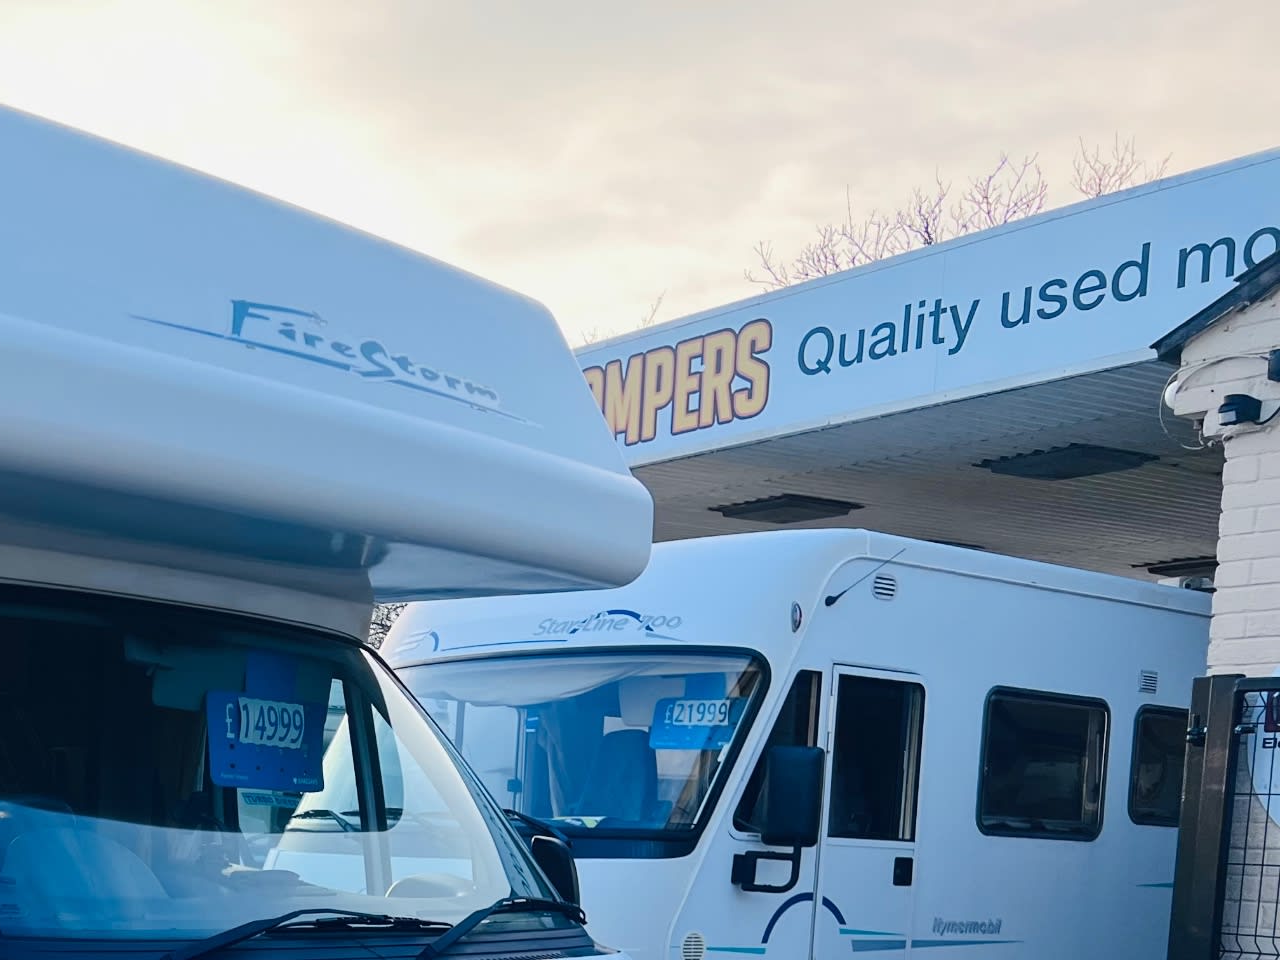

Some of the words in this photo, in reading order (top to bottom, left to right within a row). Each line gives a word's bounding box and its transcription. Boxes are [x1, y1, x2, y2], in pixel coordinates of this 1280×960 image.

[798, 298, 980, 376] Quality
[1000, 241, 1151, 329] used
[231, 299, 498, 401] FireStorm
[636, 614, 682, 633] 700
[225, 703, 304, 744] £14999
[664, 702, 728, 724] £21999
